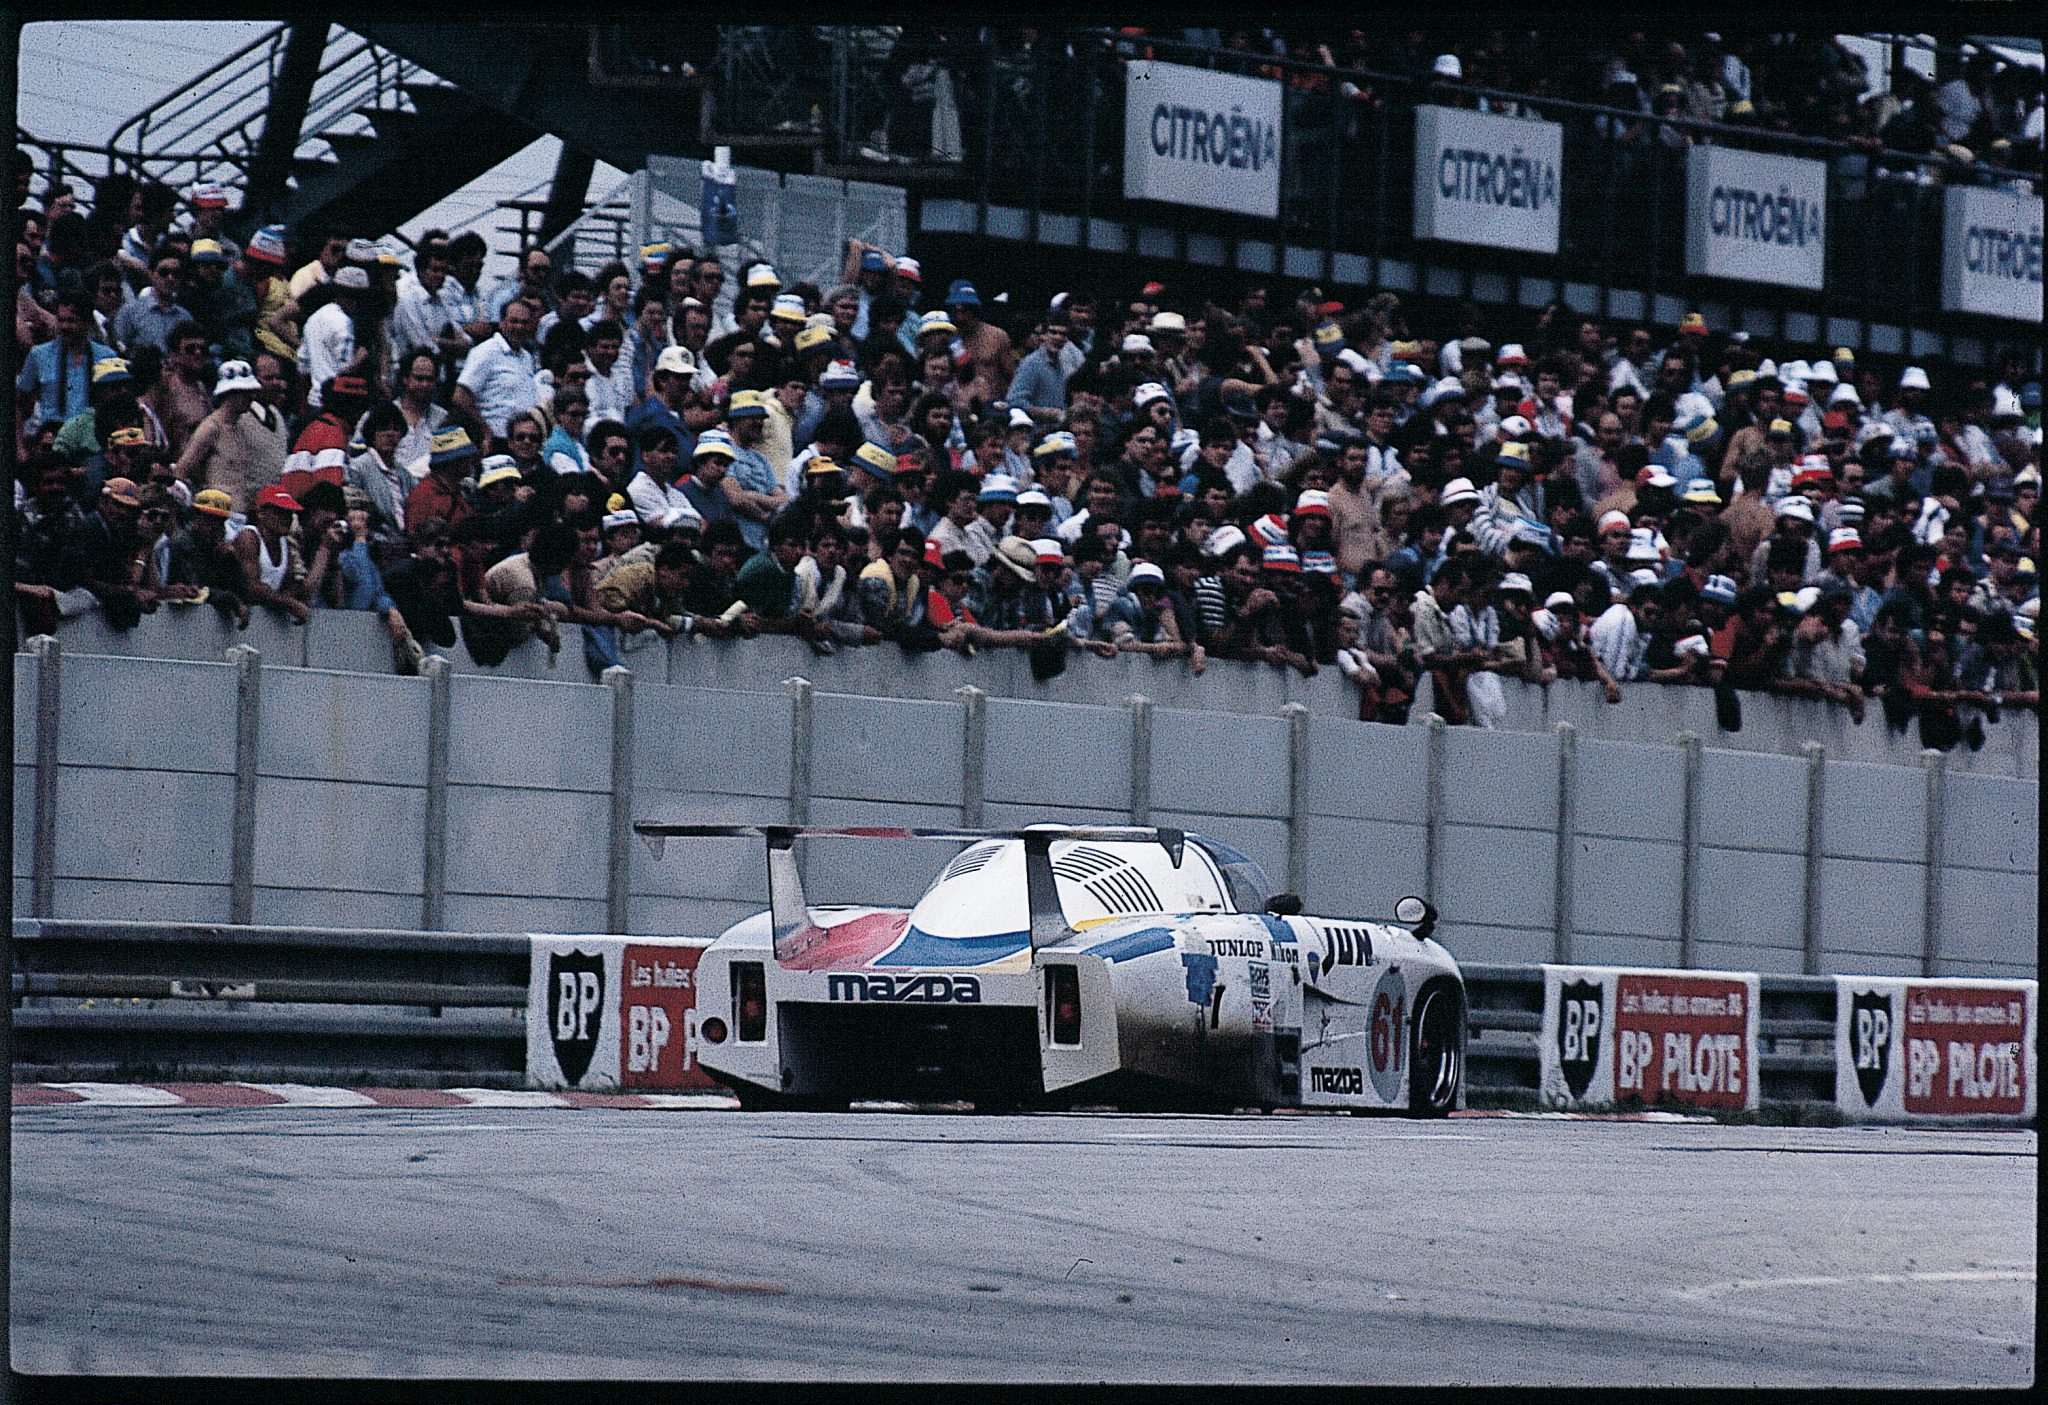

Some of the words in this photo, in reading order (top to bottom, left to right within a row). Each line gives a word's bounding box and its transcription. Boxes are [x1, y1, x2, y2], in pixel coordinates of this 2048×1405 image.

[1151, 103, 1262, 171] CITROËN
[1438, 144, 1541, 211] CITROËN
[1709, 182, 1809, 249] CITROËN
[557, 971, 601, 1041] BP
[628, 1005, 671, 1073] BP
[1371, 991, 1404, 1073] 61
[1563, 1000, 1600, 1061] BP
[1857, 1009, 1889, 1069] BP
[1619, 1030, 1654, 1089] BP
[1662, 1031, 1742, 1094] PILOTE
[1909, 1038, 1941, 1097] BP
[1948, 1041, 2020, 1098] PILOTE
